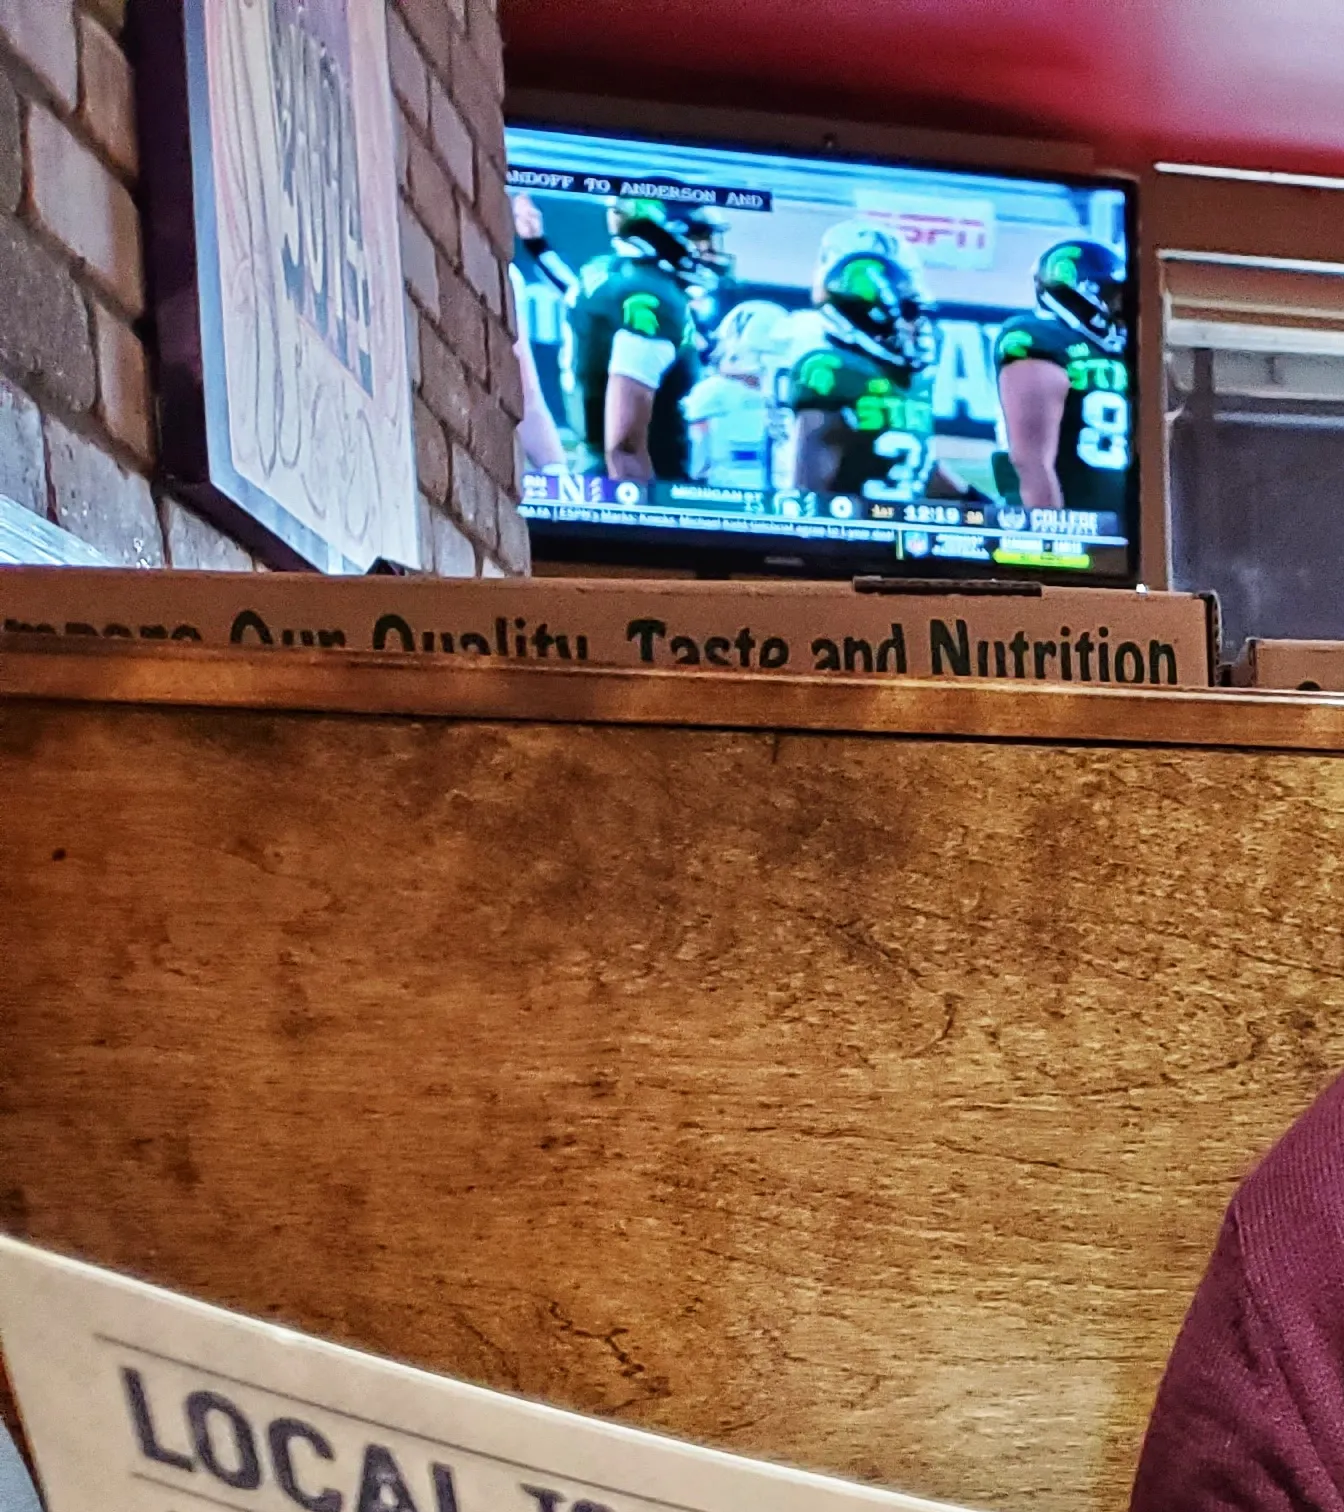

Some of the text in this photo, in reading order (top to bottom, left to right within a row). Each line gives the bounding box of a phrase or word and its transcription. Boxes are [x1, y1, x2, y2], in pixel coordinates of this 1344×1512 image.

[584, 178, 611, 193] TO
[620, 182, 717, 204] ANDERSON
[726, 193, 763, 207] AND
[811, 622, 906, 675] and
[930, 617, 1178, 685] Nutrition
